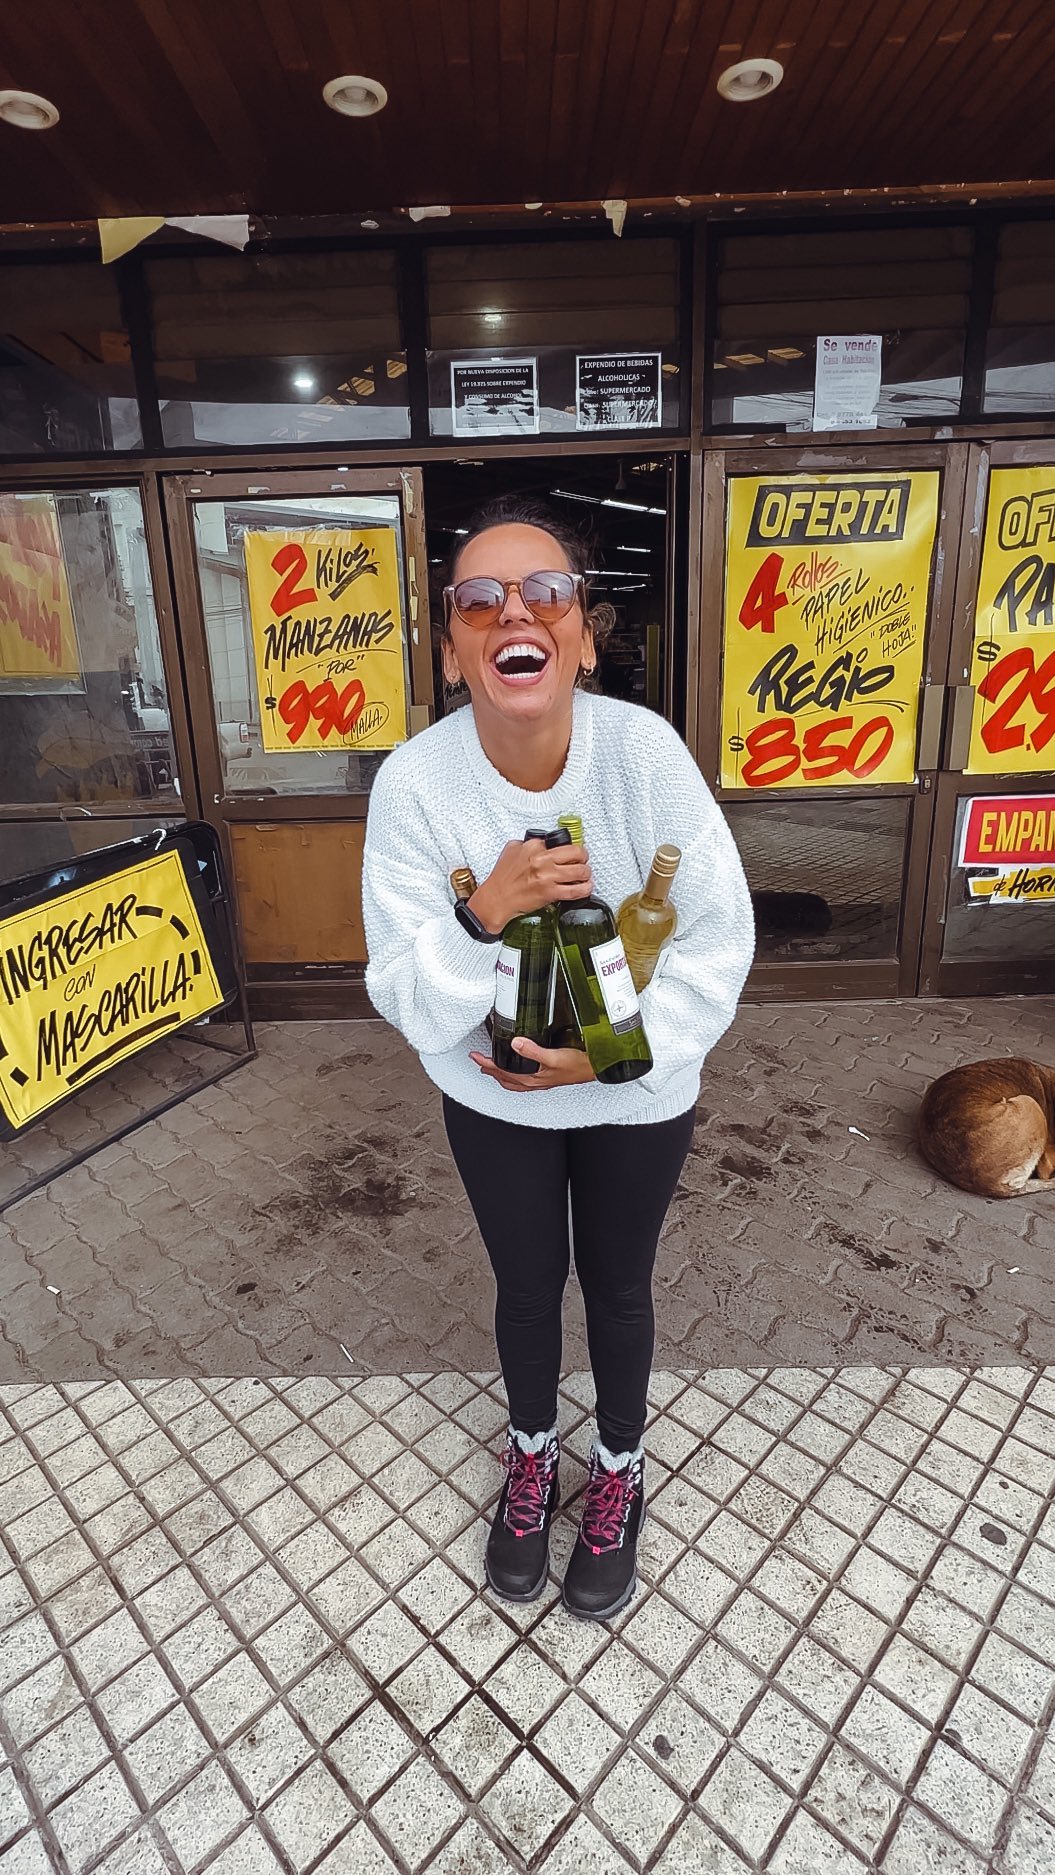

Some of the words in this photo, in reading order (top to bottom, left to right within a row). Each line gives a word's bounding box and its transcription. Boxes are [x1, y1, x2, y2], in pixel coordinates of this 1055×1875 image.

[584, 361, 616, 369] EXPENDIO
[617, 360, 626, 368] DE
[627, 359, 653, 367] BEBIDAS
[823, 339, 838, 351] Se
[845, 339, 878, 351] vende
[598, 373, 640, 382] ALCOHOLICAS
[600, 386, 651, 395] SUPERMERCADO
[758, 488, 902, 538] OFERTA
[270, 543, 318, 617] 2
[738, 552, 789, 634] 4
[801, 568, 870, 631] PAPEL
[264, 609, 395, 672] MANZANAS
[0, 894, 138, 1005] INGRESAR
